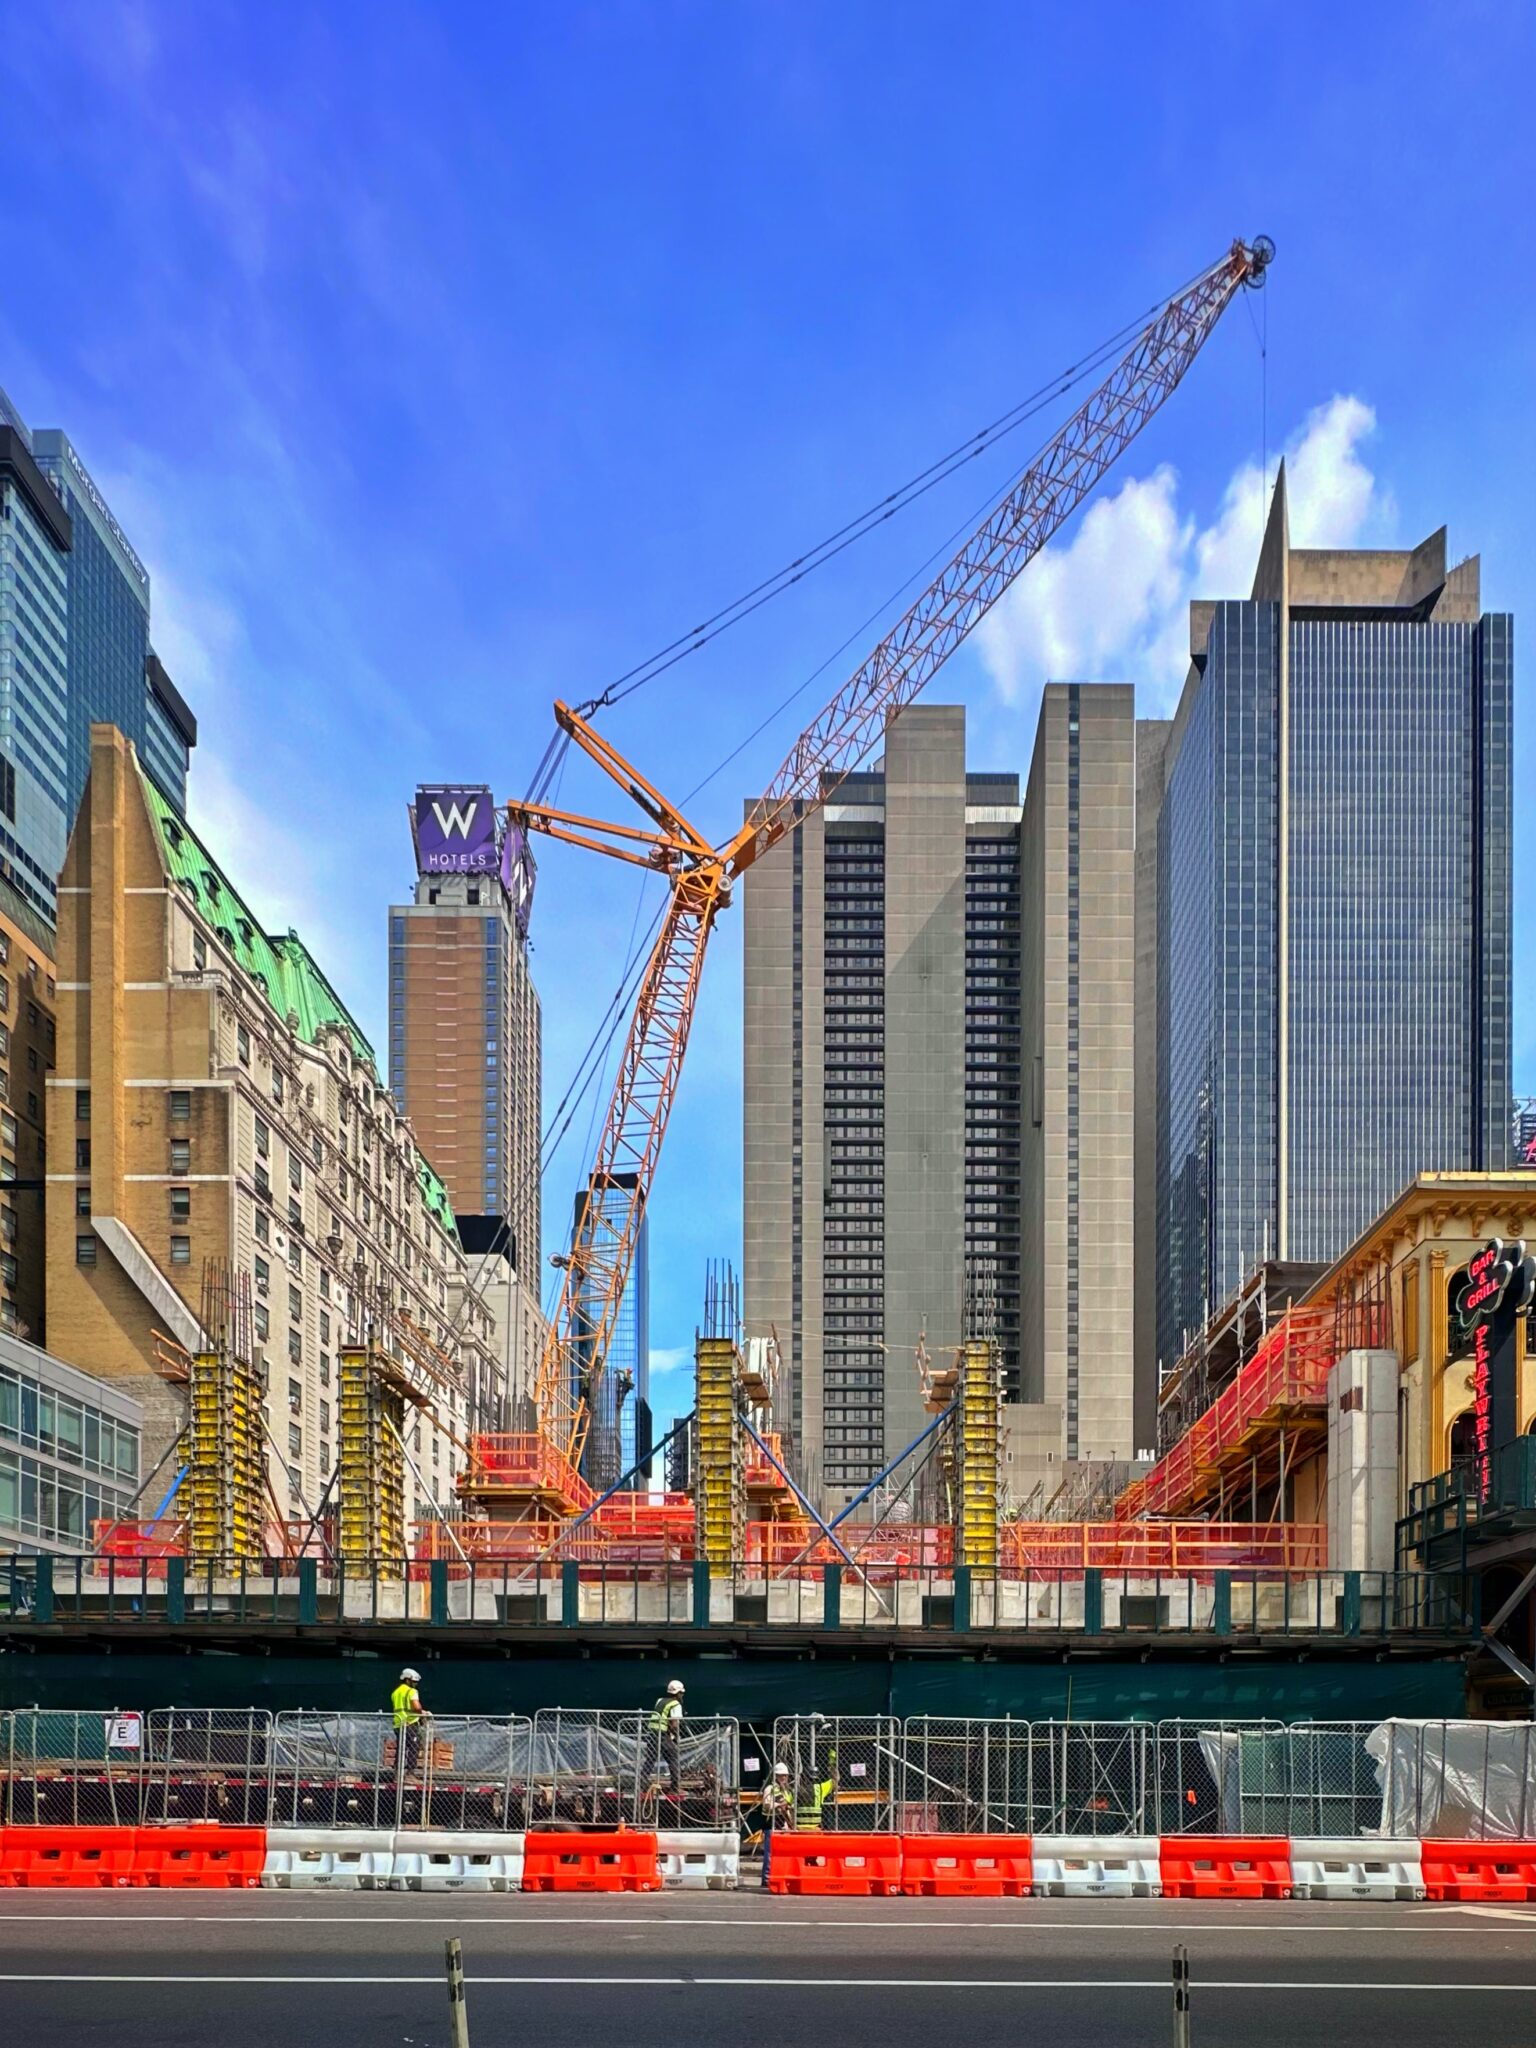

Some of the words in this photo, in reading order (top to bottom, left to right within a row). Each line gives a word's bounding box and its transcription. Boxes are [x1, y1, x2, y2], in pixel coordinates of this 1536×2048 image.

[431, 802, 478, 840] W
[429, 853, 486, 866] HOTELS
[1471, 1249, 1495, 1277] BAR
[1478, 1271, 1488, 1286] &
[1467, 1277, 1502, 1309] GRILL
[118, 1726, 128, 1739] E
